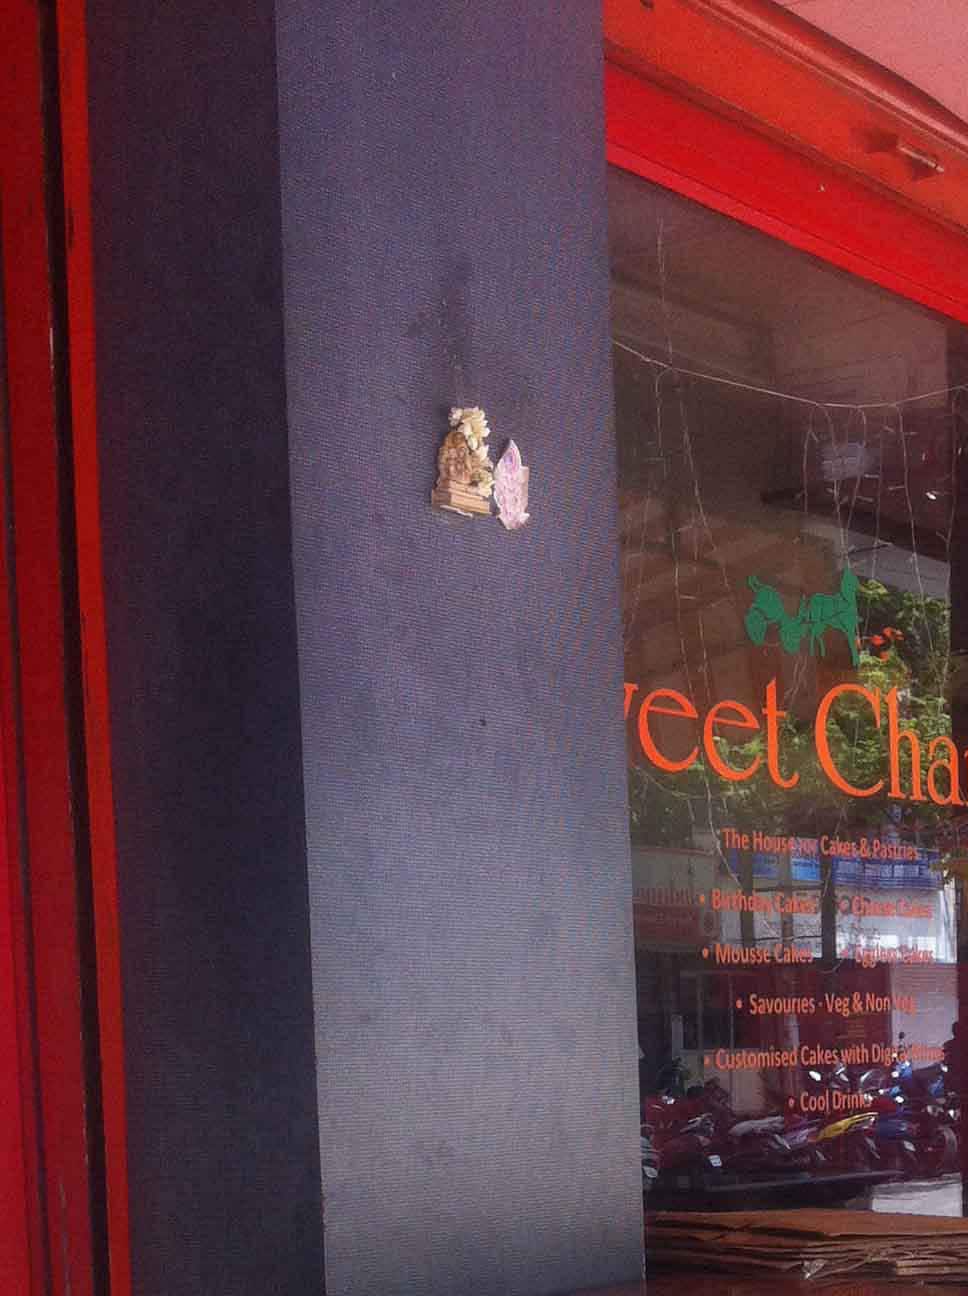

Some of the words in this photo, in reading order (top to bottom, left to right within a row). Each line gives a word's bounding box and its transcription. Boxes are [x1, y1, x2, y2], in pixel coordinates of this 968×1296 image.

[623, 677, 800, 789] eet
[722, 828, 749, 849] The
[752, 830, 794, 854] House
[820, 834, 856, 857] Cakes
[859, 837, 868, 858] &
[872, 838, 919, 861] Pastries
[711, 888, 773, 915] Birthday
[774, 891, 817, 914] Cakes
[715, 943, 770, 964] Mousse
[774, 943, 814, 964] Cakes
[750, 993, 815, 1015] Savouries
[825, 993, 850, 1016] Veg
[852, 992, 864, 1012] &
[866, 993, 890, 1013] Non
[715, 1046, 798, 1070] Customised
[800, 1045, 838, 1066] Cakes
[841, 1044, 870, 1065] with
[800, 1091, 831, 1113] Cool
[833, 1090, 872, 1110] Drinks
